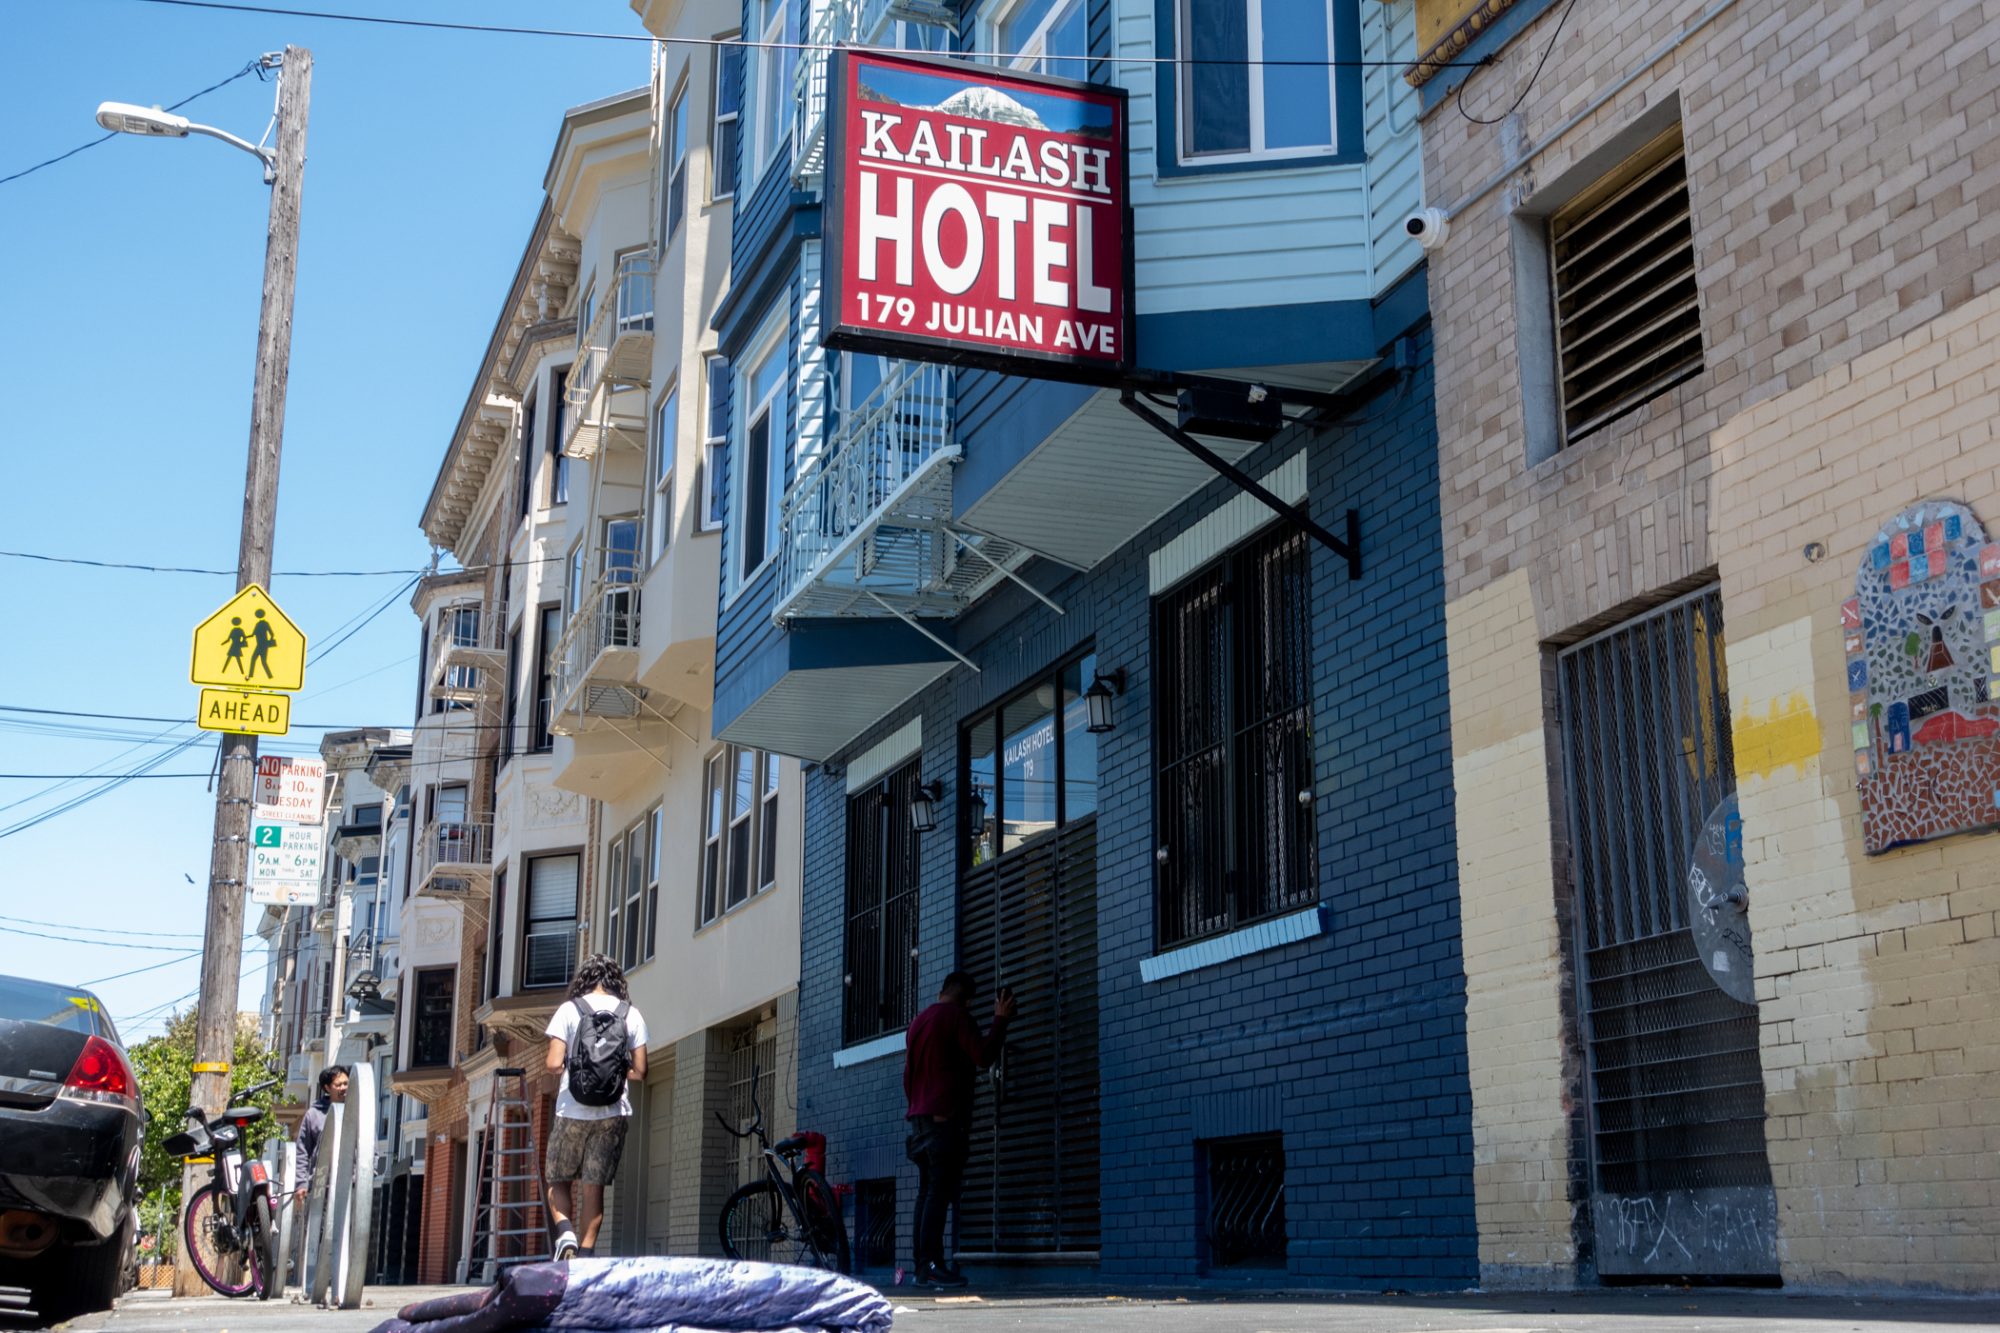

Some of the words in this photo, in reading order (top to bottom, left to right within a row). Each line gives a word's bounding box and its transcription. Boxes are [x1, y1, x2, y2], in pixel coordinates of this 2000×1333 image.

[859, 108, 1112, 195] KAILASH
[858, 170, 1112, 314] HOTEL
[857, 291, 915, 327] 179
[925, 301, 1043, 345] JULIAN
[1054, 318, 1115, 354] AVE
[208, 700, 280, 723] AHEAD
[1004, 737, 1031, 768] KAILASH
[1032, 724, 1054, 752] HOTEL
[261, 757, 280, 775] NO
[281, 763, 323, 778] PARKING
[1023, 758, 1034, 780] 179
[265, 794, 313, 809] TUESDAY
[262, 809, 283, 819] STREET
[262, 827, 273, 844] 2
[289, 831, 312, 840] HOUR
[283, 841, 319, 852] PARKING
[259, 867, 276, 877] MON
[299, 869, 313, 878] SAT
